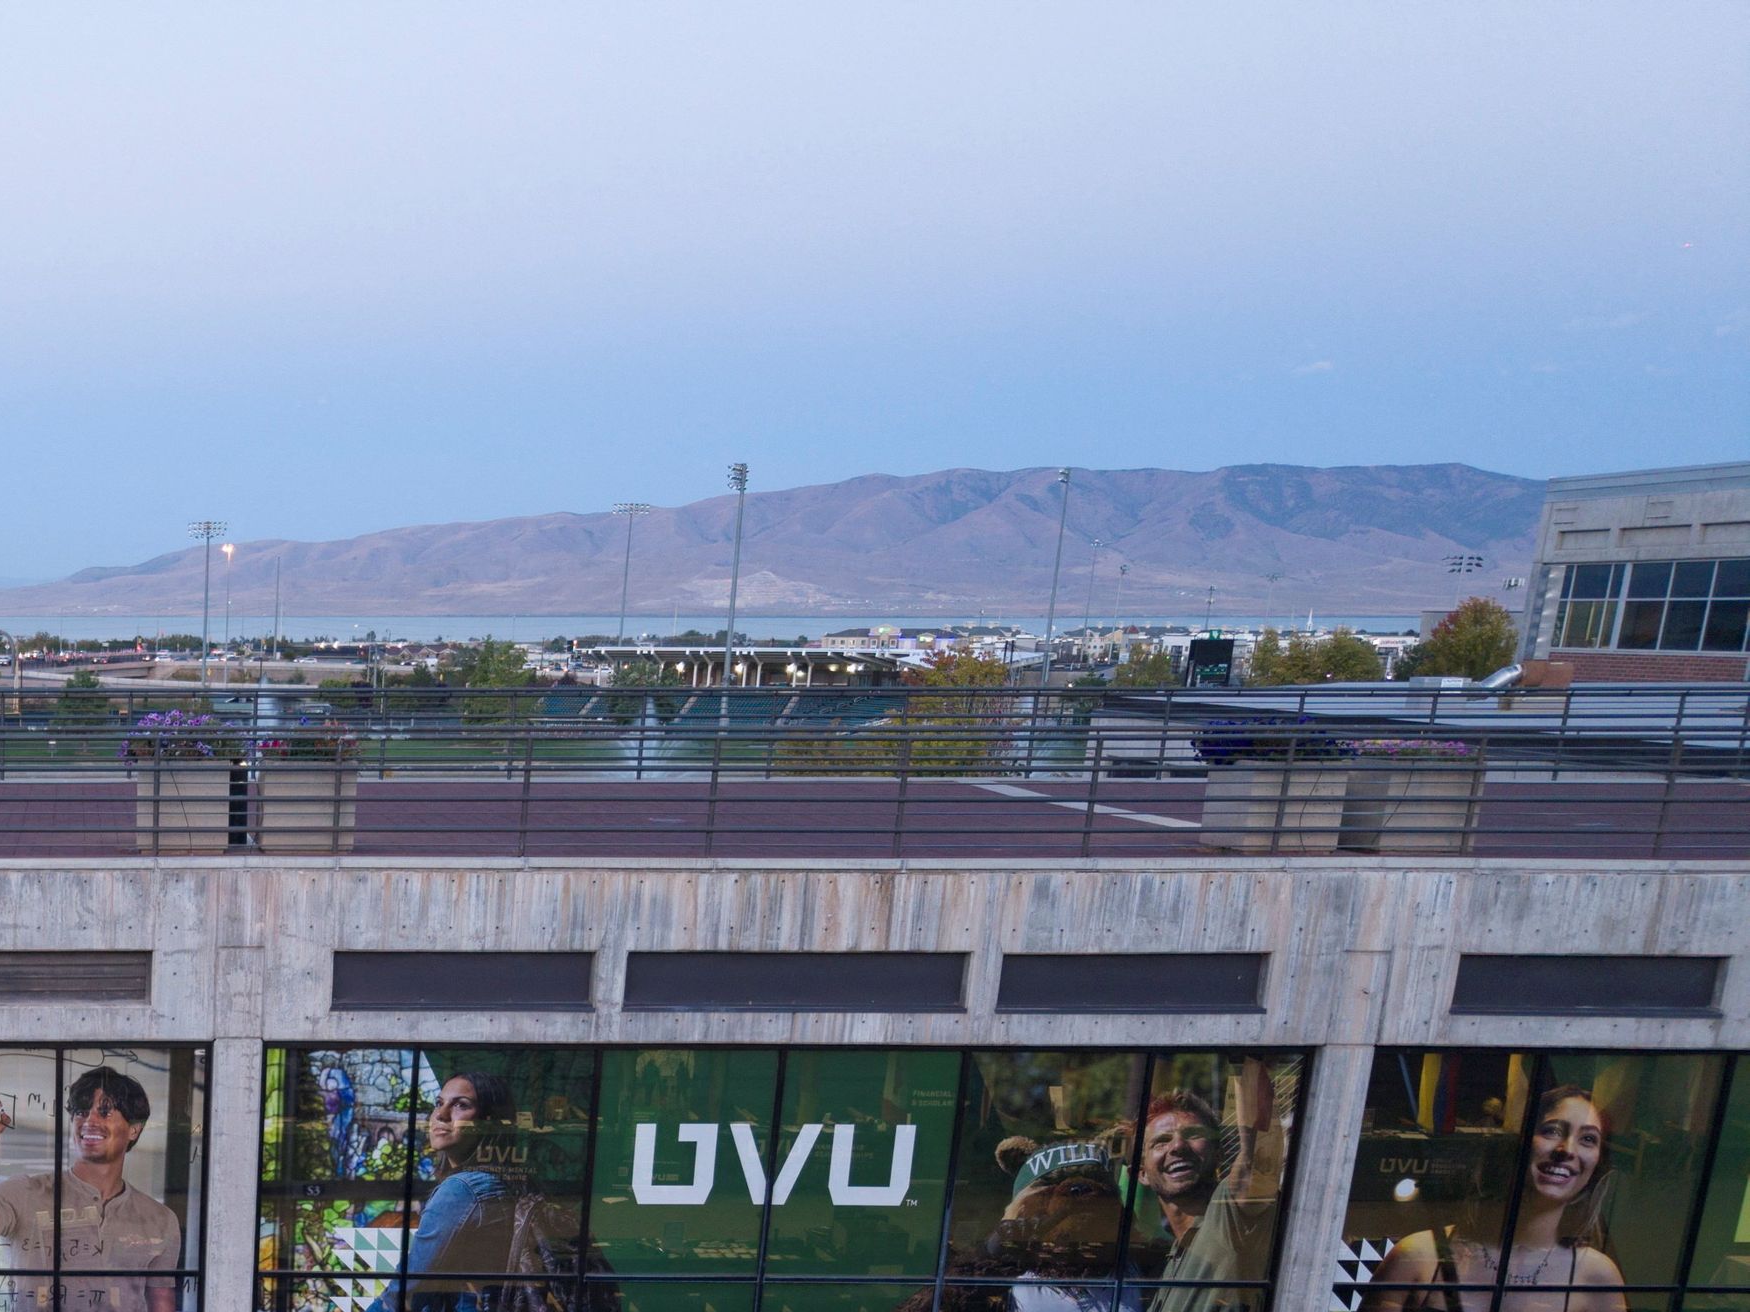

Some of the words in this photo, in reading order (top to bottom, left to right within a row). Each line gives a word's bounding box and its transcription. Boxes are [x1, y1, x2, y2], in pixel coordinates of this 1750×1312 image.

[476, 1146, 528, 1163] UVU
[632, 1123, 917, 1206] UVU
[1379, 1157, 1430, 1174] UVU
[306, 1185, 321, 1196] S3
